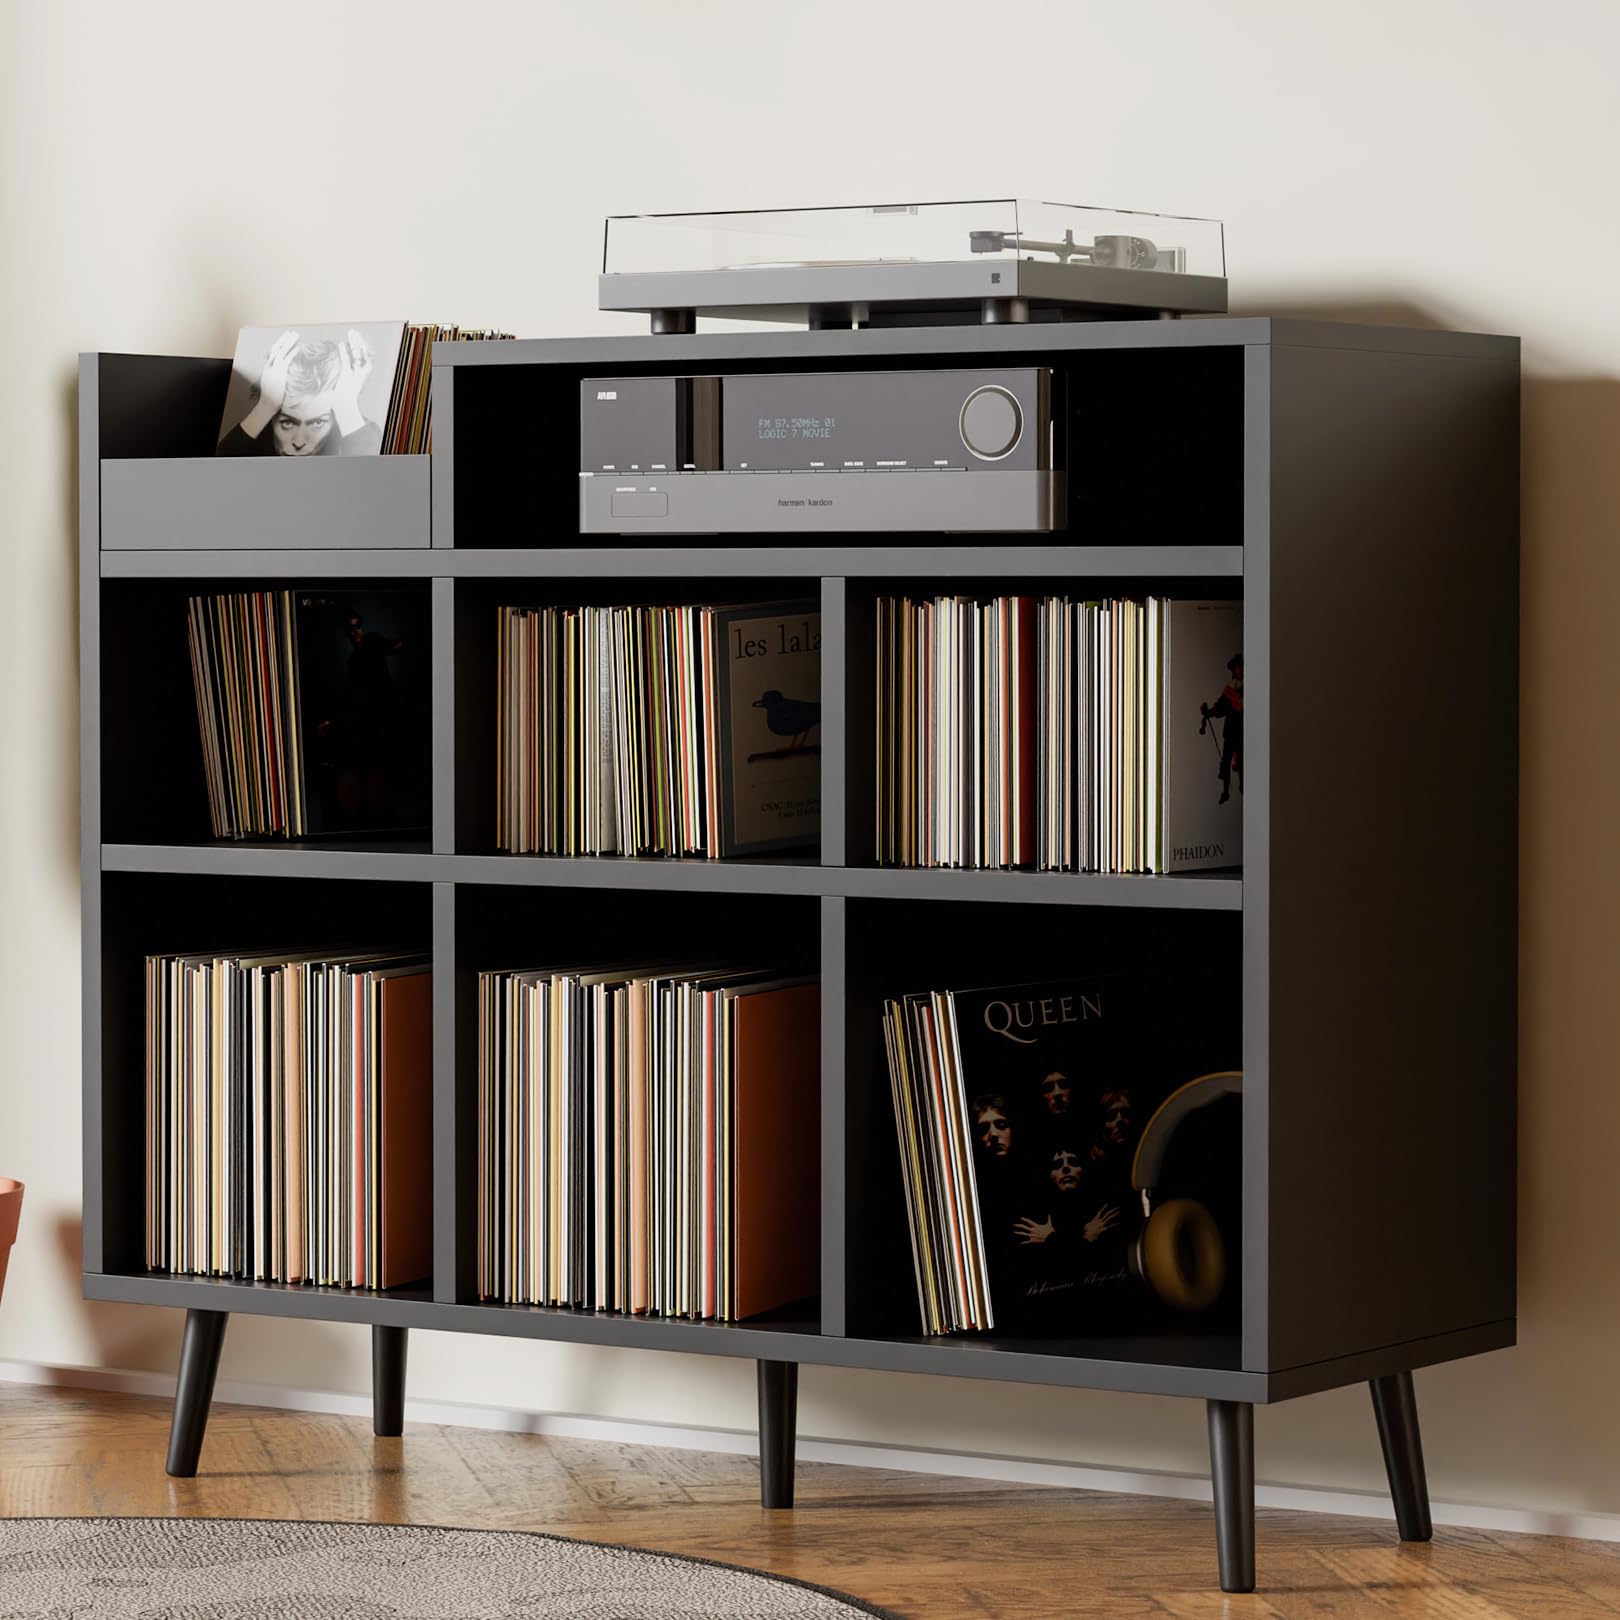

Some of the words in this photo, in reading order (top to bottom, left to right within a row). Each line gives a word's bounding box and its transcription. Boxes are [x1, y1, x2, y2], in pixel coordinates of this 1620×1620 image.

[758, 418, 771, 428] FM
[758, 429, 787, 439] LOGIC
[791, 428, 798, 439] 7
[802, 428, 832, 438] MOVIE
[778, 498, 805, 507] harman
[807, 498, 833, 506] kardon
[733, 627, 768, 659] les
[1172, 843, 1225, 862] PHAIDON
[983, 993, 1102, 1044] QUEEN
